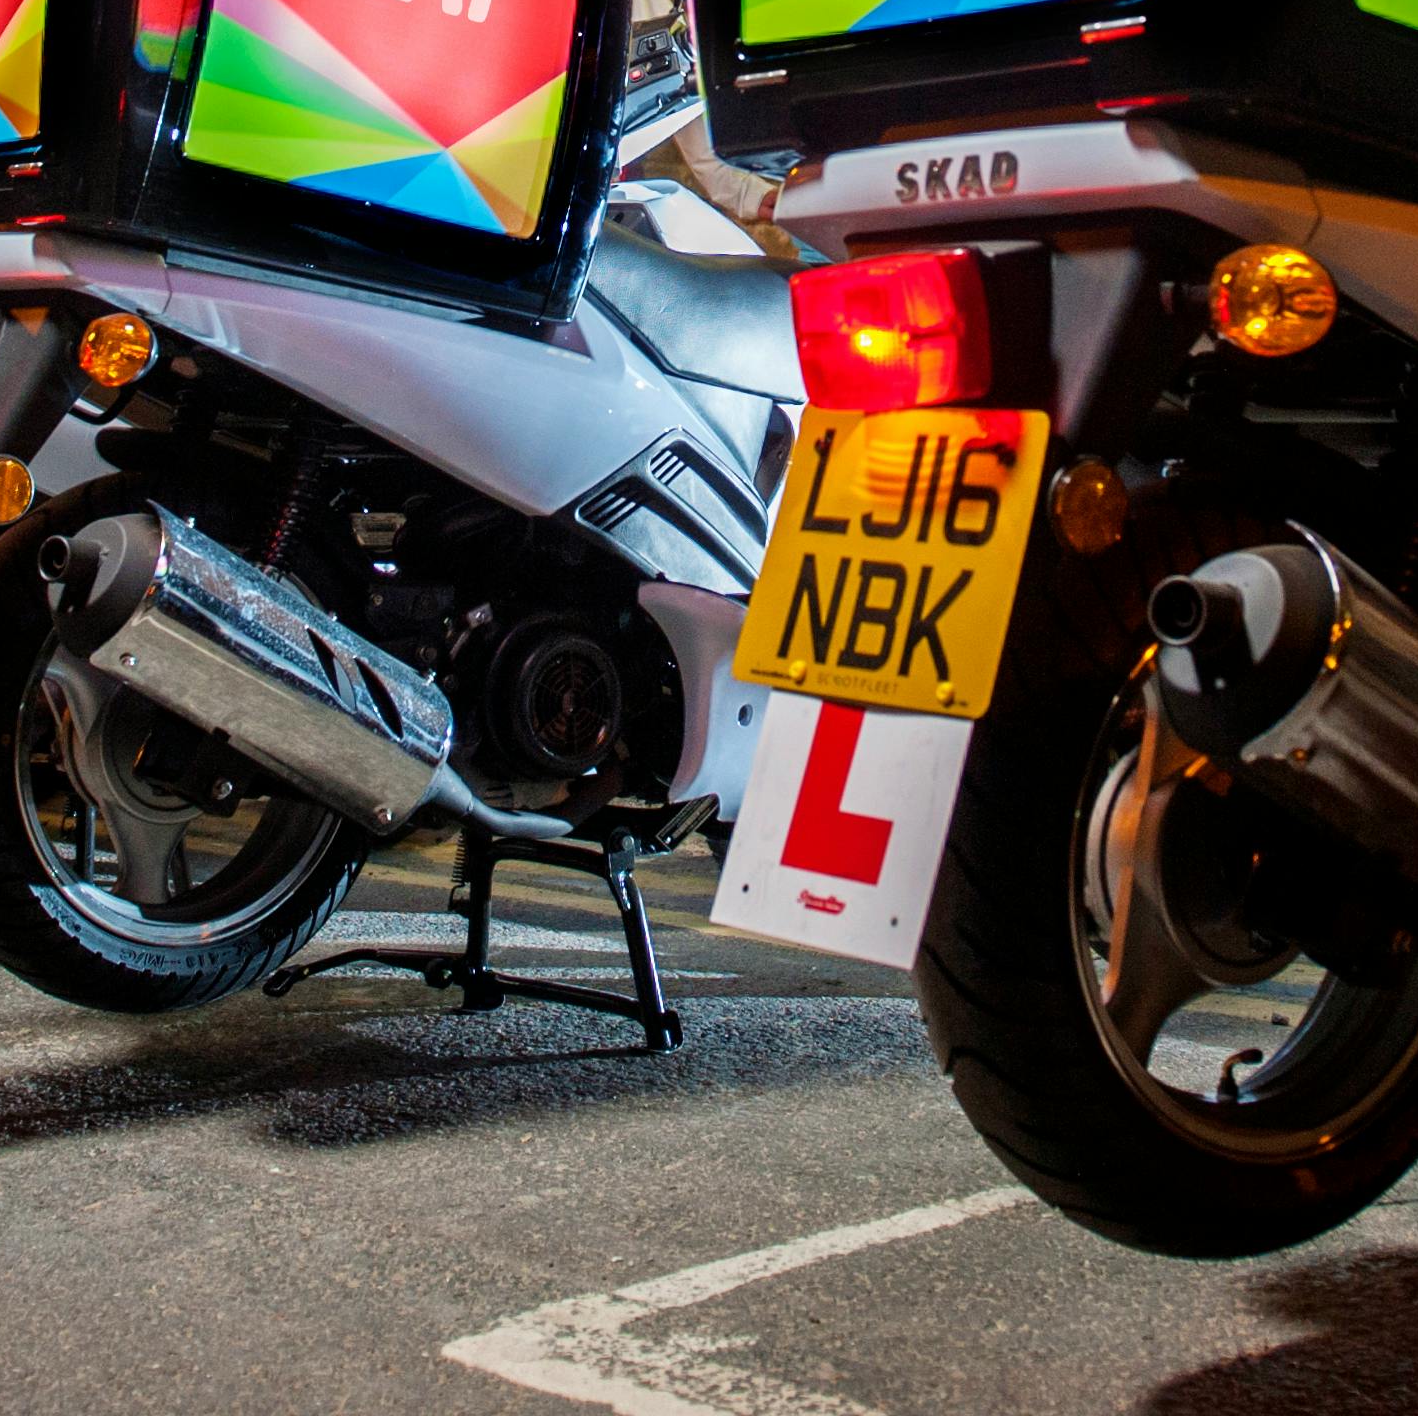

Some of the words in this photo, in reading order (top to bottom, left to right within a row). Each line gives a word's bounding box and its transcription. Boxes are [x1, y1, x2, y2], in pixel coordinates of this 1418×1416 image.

[895, 150, 1019, 204] SKAD
[799, 428, 1014, 547] LJ16
[777, 553, 974, 682] NBK
[779, 700, 894, 887] L
